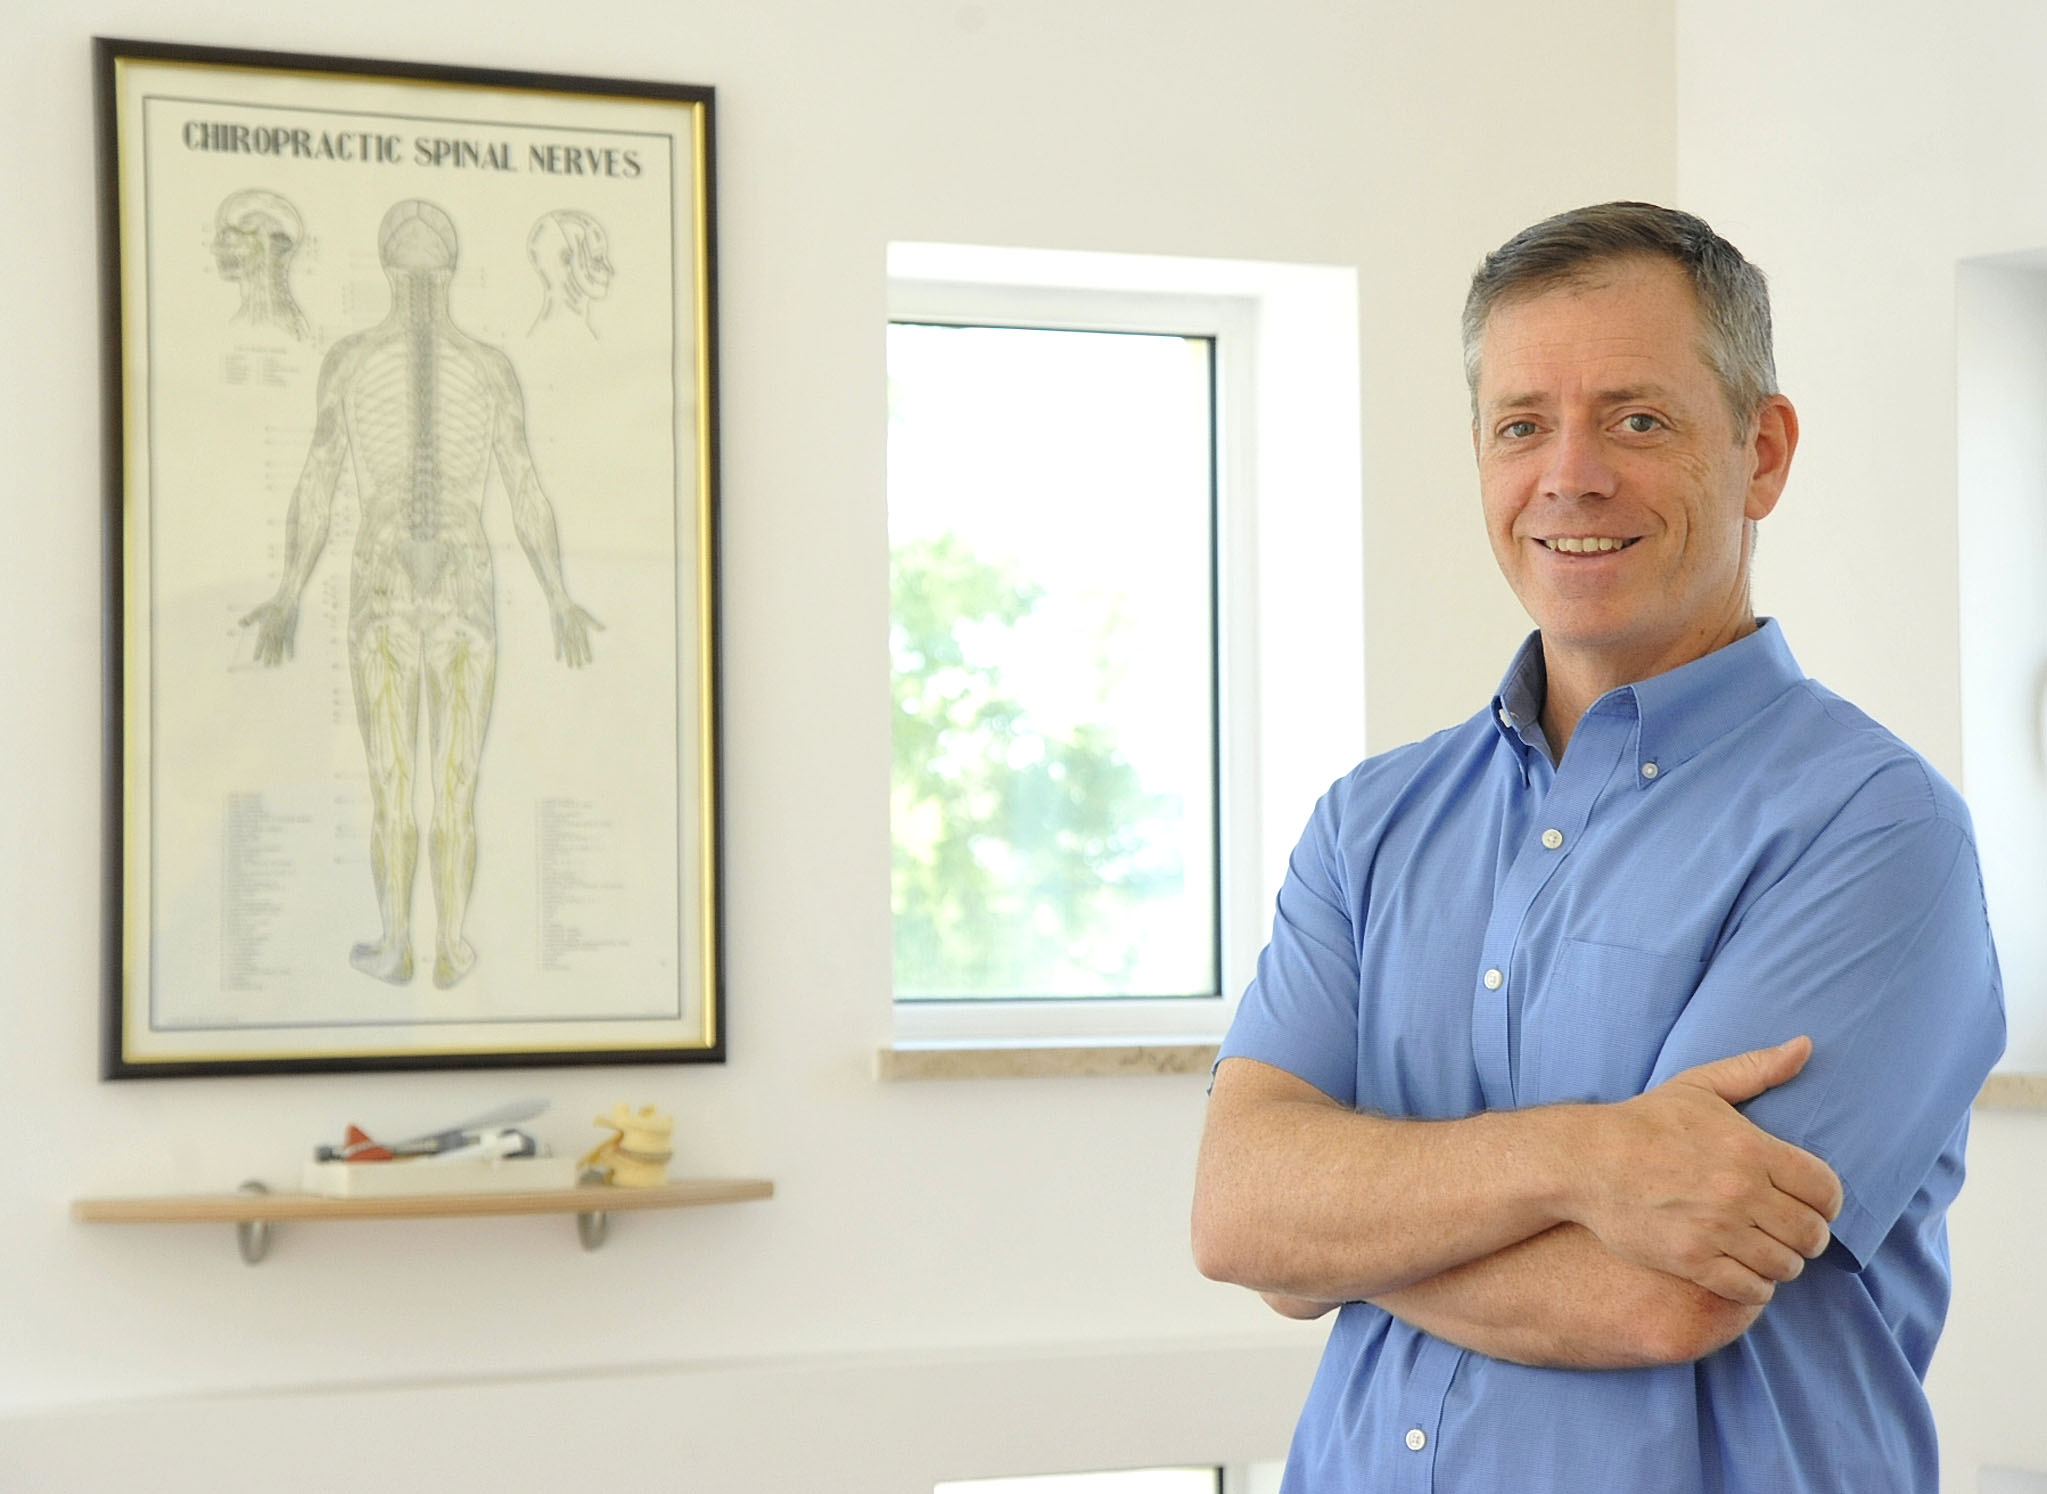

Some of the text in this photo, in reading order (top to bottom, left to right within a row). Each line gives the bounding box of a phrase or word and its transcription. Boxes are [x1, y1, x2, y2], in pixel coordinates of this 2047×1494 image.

[182, 120, 642, 178] CHIROPRACTIC SPINAL NERVES
